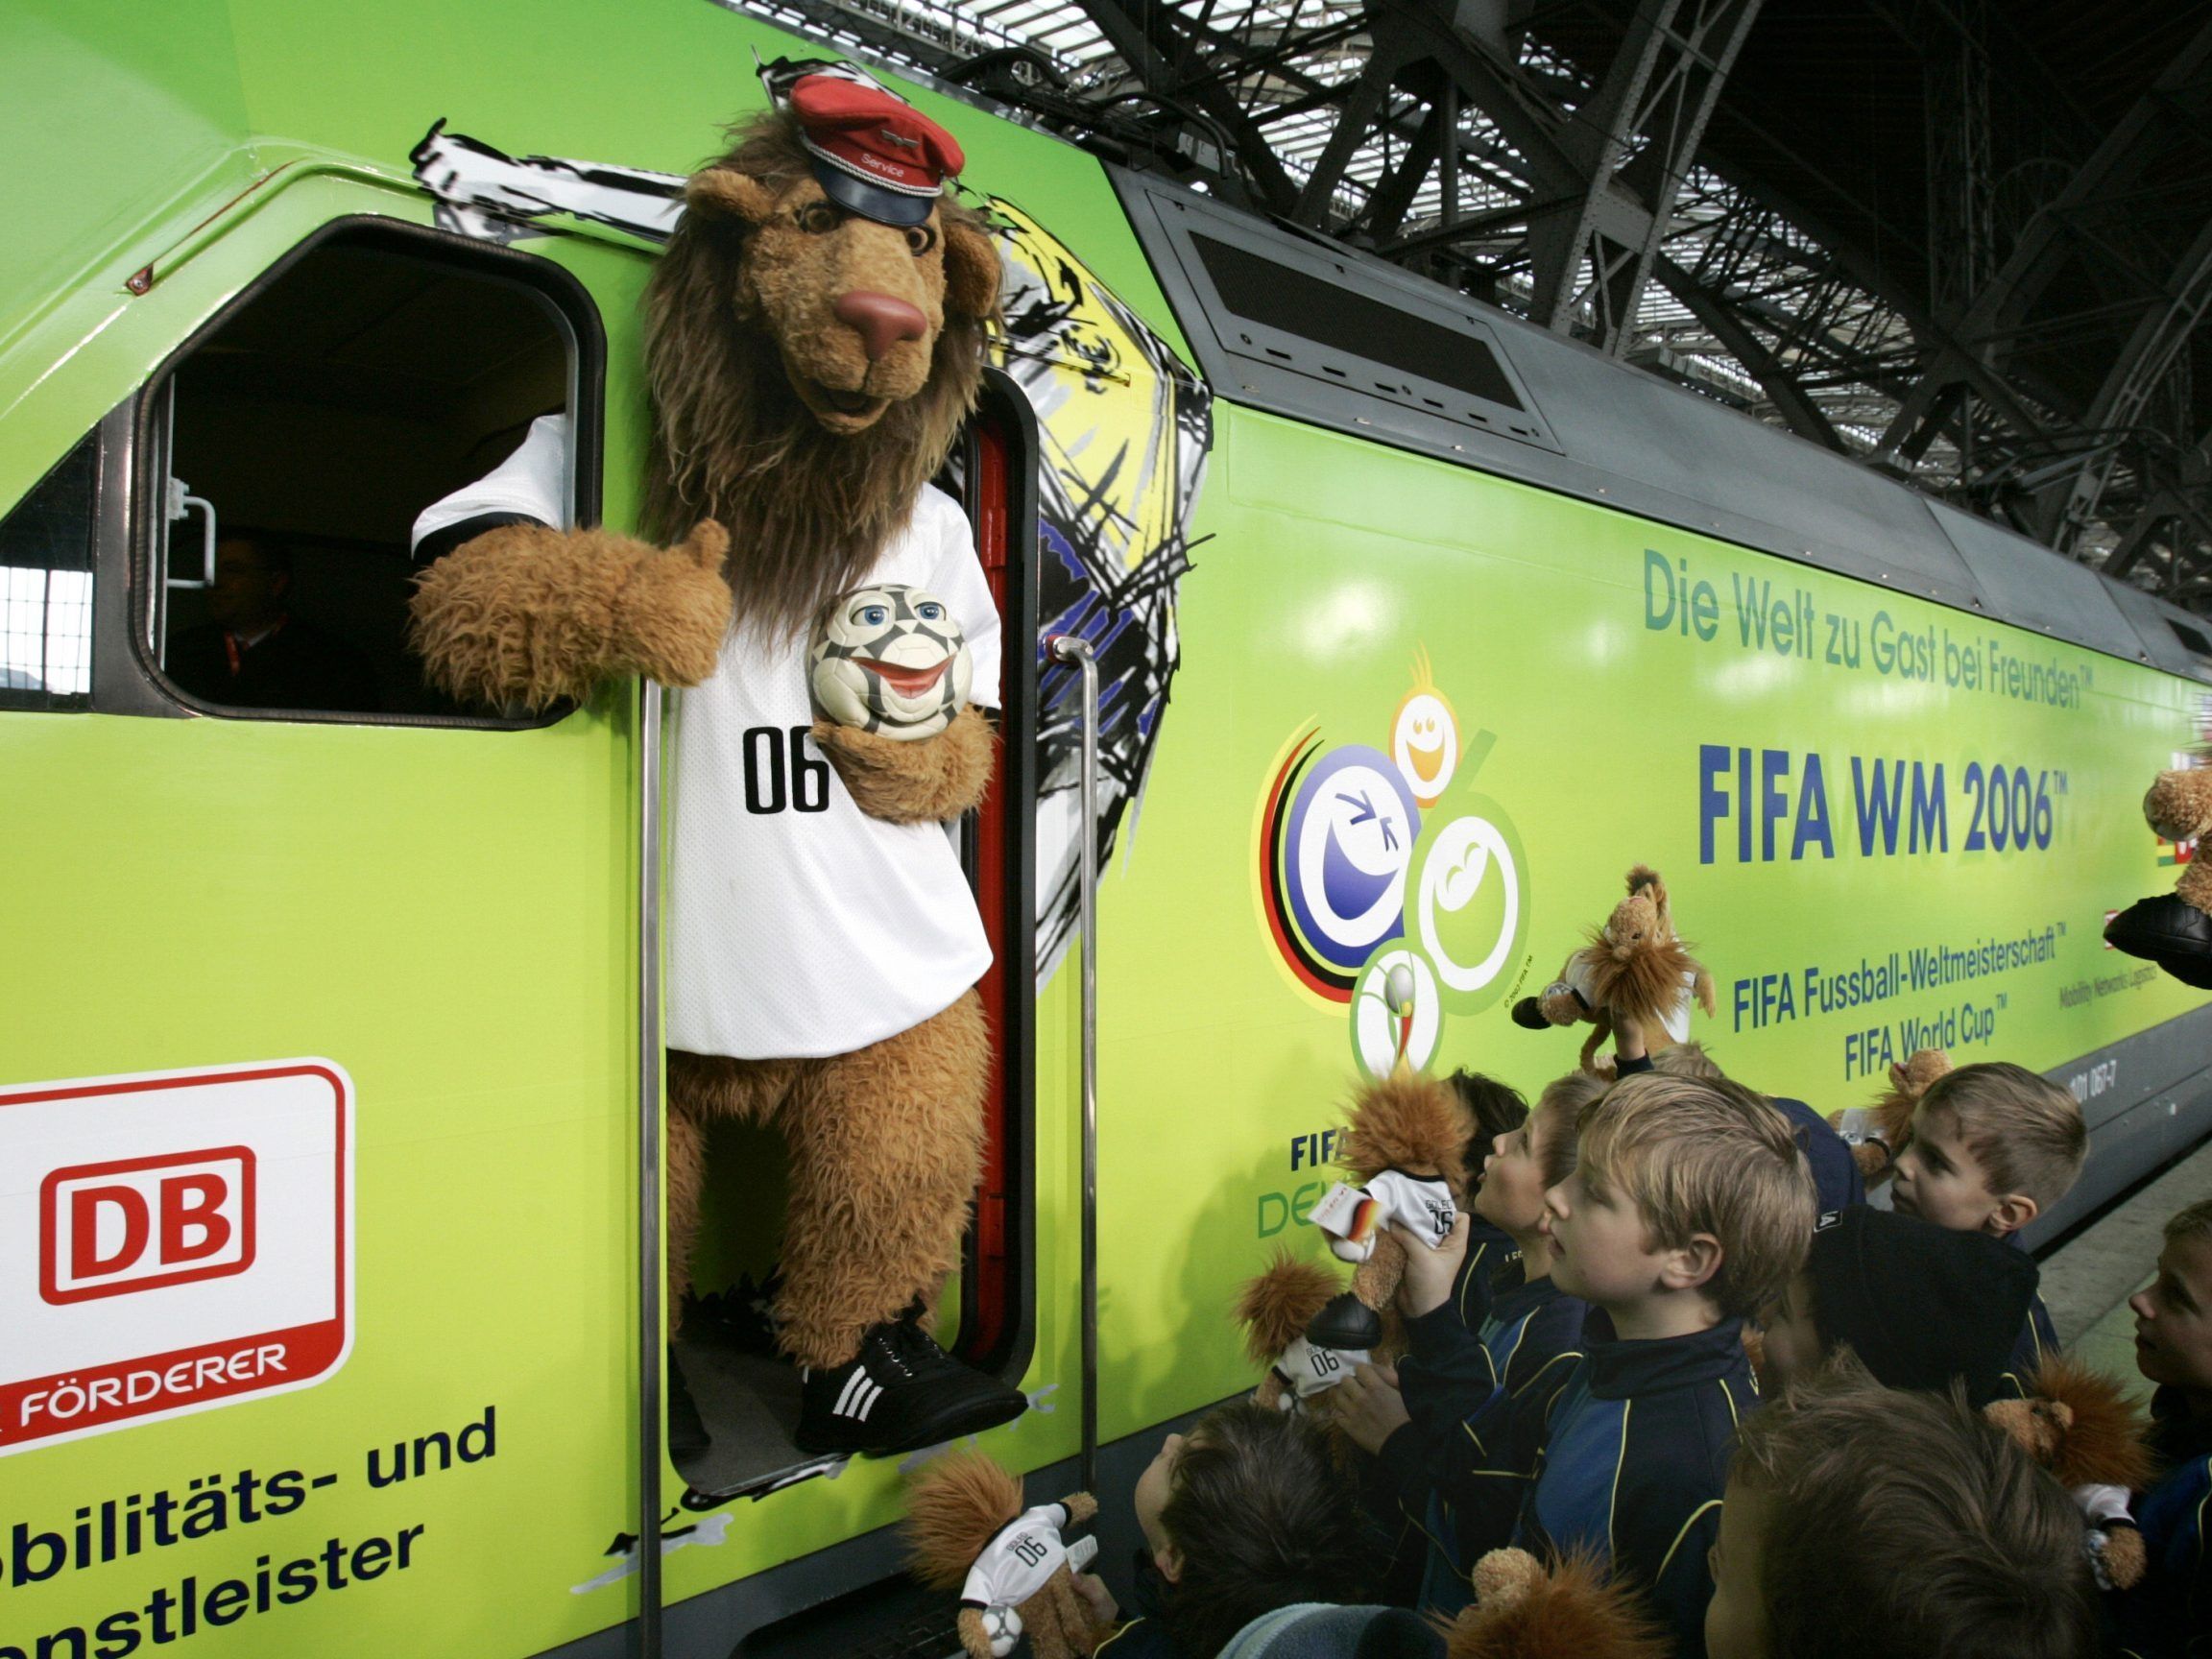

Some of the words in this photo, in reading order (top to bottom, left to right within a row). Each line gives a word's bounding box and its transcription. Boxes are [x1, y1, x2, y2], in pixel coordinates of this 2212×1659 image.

[860, 153, 904, 178] Service
[1644, 548, 1719, 641] Die
[1732, 571, 1814, 660] Welt
[1825, 614, 1860, 669] zu
[1870, 610, 1936, 685] Gast
[1944, 629, 1983, 690] bei
[742, 725, 830, 815] 06
[1699, 744, 1834, 864] FIFA
[1851, 756, 1948, 856] WM
[1734, 972, 1795, 1033] FIFA
[1845, 1025, 1894, 1082] FIFA
[1900, 1008, 1956, 1062] World
[71, 1172, 231, 1281] DB
[20, 1343, 287, 1428] FÖRDERER
[1310, 1346, 1340, 1377] 06
[0, 1468, 338, 1589] bilitäts-
[366, 1405, 497, 1490] und
[0, 1523, 425, 1659] nstleister
[1015, 1536, 1047, 1568] 06
